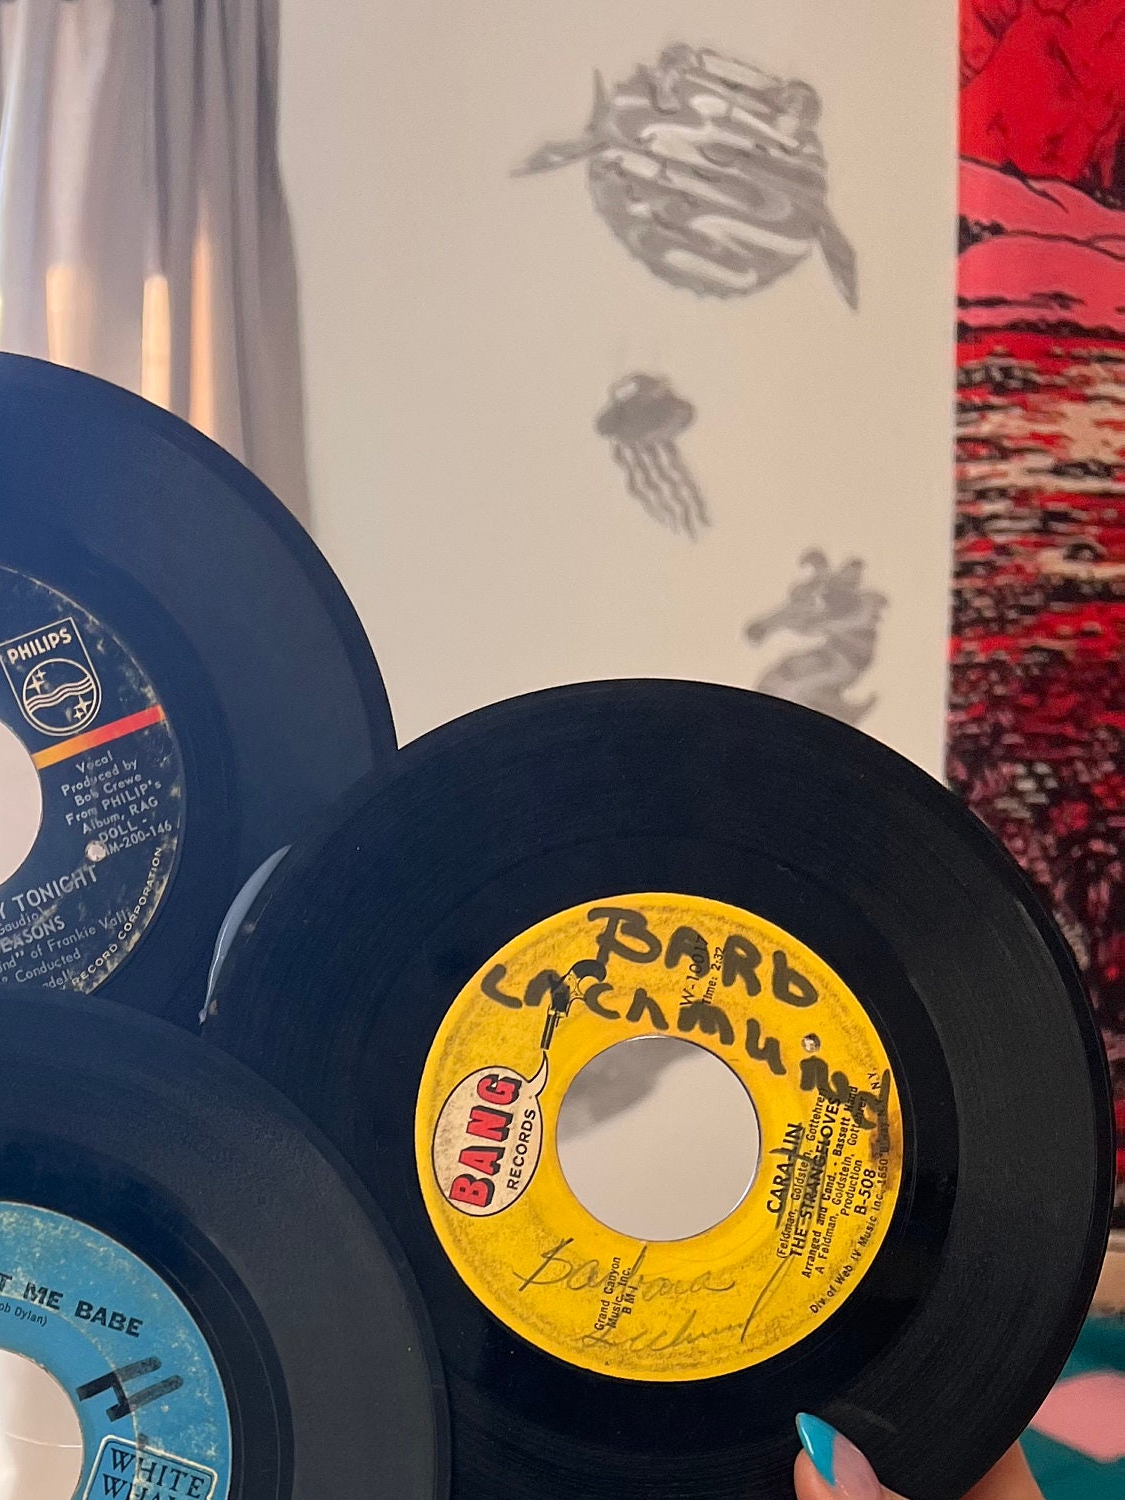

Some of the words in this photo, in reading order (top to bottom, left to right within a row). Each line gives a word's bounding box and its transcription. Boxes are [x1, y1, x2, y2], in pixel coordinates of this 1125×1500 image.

[7, 628, 72, 665] PHILIPS
[61, 764, 119, 796] Produced
[122, 759, 137, 771] by
[76, 750, 113, 773] Vocal
[65, 807, 98, 825] From
[101, 779, 162, 811] PHILIP's
[74, 789, 100, 807] Bob
[103, 774, 142, 794] Crewe
[83, 813, 125, 834] Album,
[128, 796, 158, 817] RAG
[98, 820, 138, 843] DOLL
[12, 864, 97, 912] TONIGHT
[72, 943, 118, 986] RECORD
[118, 847, 163, 940] CORPORATION
[15, 949, 81, 983] Conducted
[31, 945, 43, 959] of
[47, 927, 96, 952] Frankie
[701, 977, 717, 1005] Time:
[449, 1074, 522, 1207] BANG
[507, 1109, 536, 1190] RECORDS
[767, 1123, 803, 1213] CARA-LIN
[790, 1232, 808, 1257] THE
[801, 1098, 841, 1222] STRANGELOVES
[841, 1159, 863, 1217] Production
[802, 1230, 822, 1279] Arranged
[816, 1206, 828, 1226] and
[822, 1171, 838, 1202] Cond.
[833, 1114, 851, 1158] Bassett
[854, 1169, 876, 1216] B-508
[827, 1285, 838, 1298] of
[834, 1264, 853, 1286] Web
[850, 1248, 862, 1261] IV
[858, 1217, 877, 1247] Music
[879, 1158, 889, 1184] 1650
[618, 1267, 631, 1287] Inc.
[815, 1265, 825, 1275] A
[14, 1306, 48, 1327] Dylan)
[22, 1281, 64, 1310] ME
[75, 1300, 144, 1338] BABE
[594, 1299, 610, 1331] Grand
[603, 1256, 621, 1295] Canyon
[111, 1448, 205, 1499] WHITE
